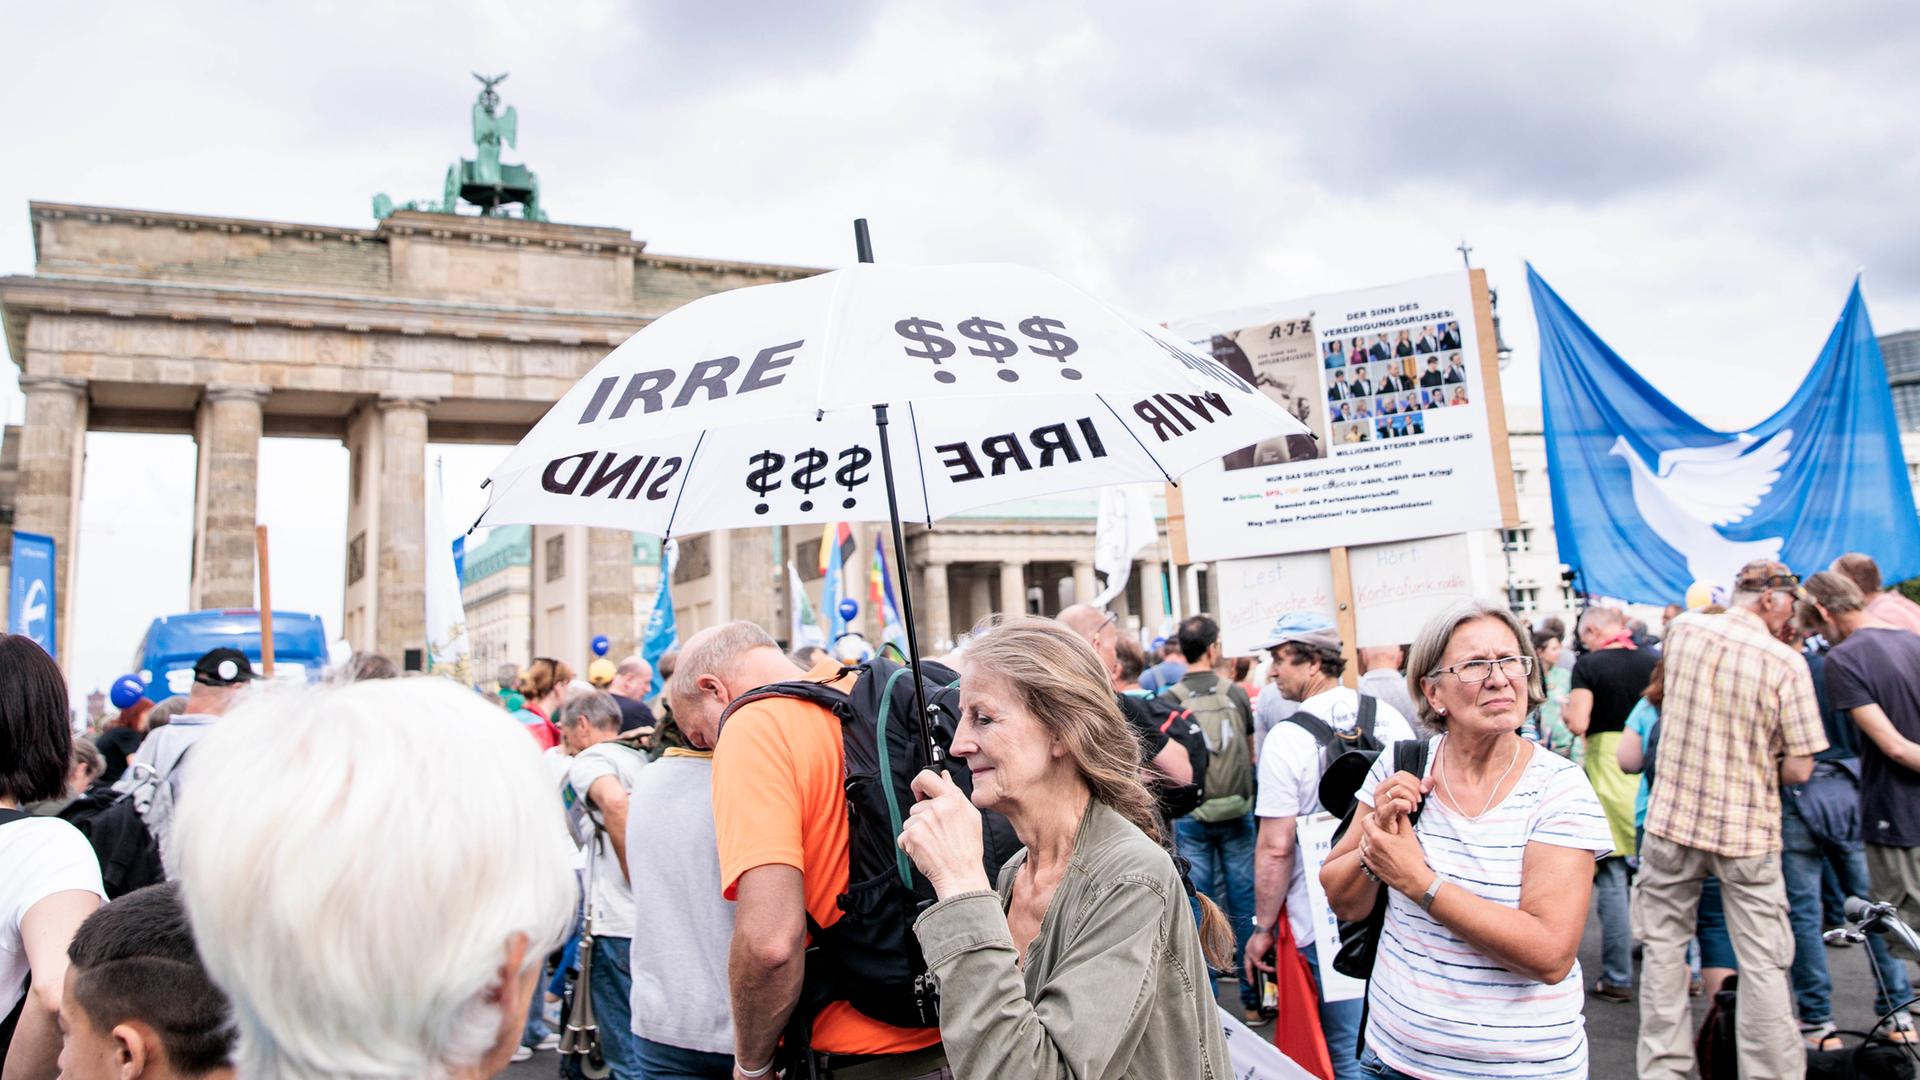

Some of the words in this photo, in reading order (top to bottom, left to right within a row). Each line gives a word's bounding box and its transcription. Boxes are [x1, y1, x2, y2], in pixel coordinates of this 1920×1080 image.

[1346, 312, 1367, 321] DER
[1370, 306, 1395, 317] SINN
[1399, 302, 1420, 312] DES
[577, 339, 805, 425] IRRE
[1336, 446, 1381, 457] MILLIONEN
[1384, 441, 1416, 451] STEHEN
[1419, 436, 1450, 446] HINTER
[1303, 467, 1346, 478] DEUTSCHE
[1349, 464, 1370, 473] VOLK
